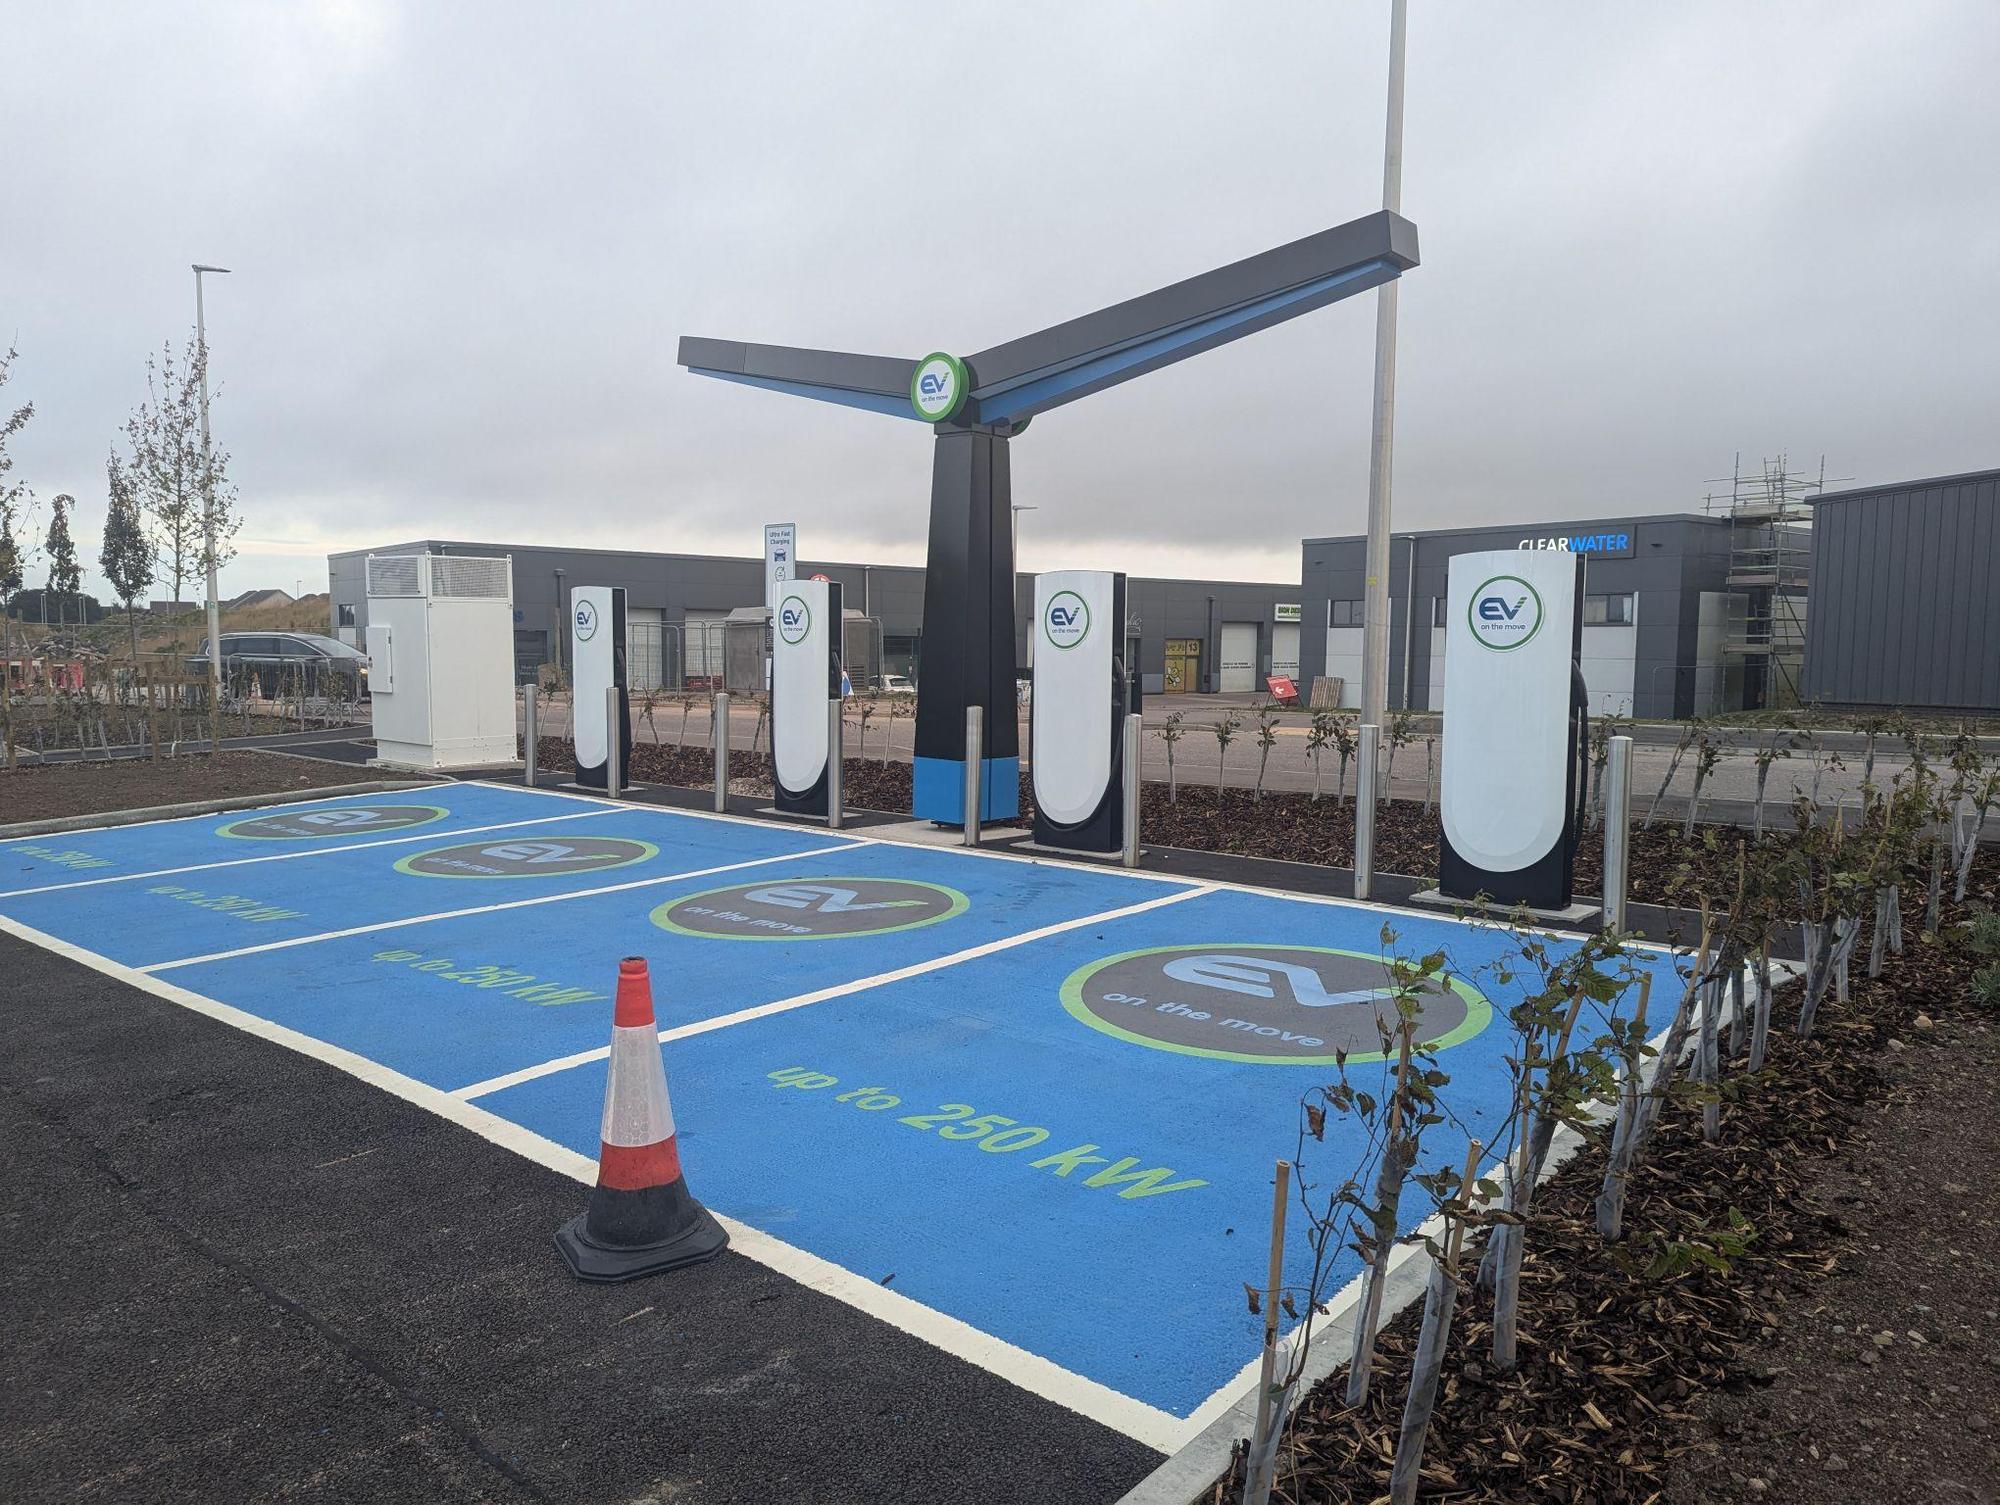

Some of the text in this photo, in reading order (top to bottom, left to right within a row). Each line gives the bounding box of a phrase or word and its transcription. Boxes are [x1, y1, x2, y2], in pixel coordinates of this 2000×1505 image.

[920, 372, 950, 395] EV
[576, 611, 592, 625] EV
[782, 609, 804, 625] EV
[1050, 606, 1081, 626] EV
[1479, 596, 1528, 620] EV
[1491, 622, 1503, 630] the
[744, 884, 929, 913] EV
[682, 905, 814, 934] on the move
[436, 965, 537, 989] 250
[501, 981, 611, 1007] kW
[1102, 991, 1325, 1048] on the move
[766, 1065, 1212, 1200] up to 250 kW
